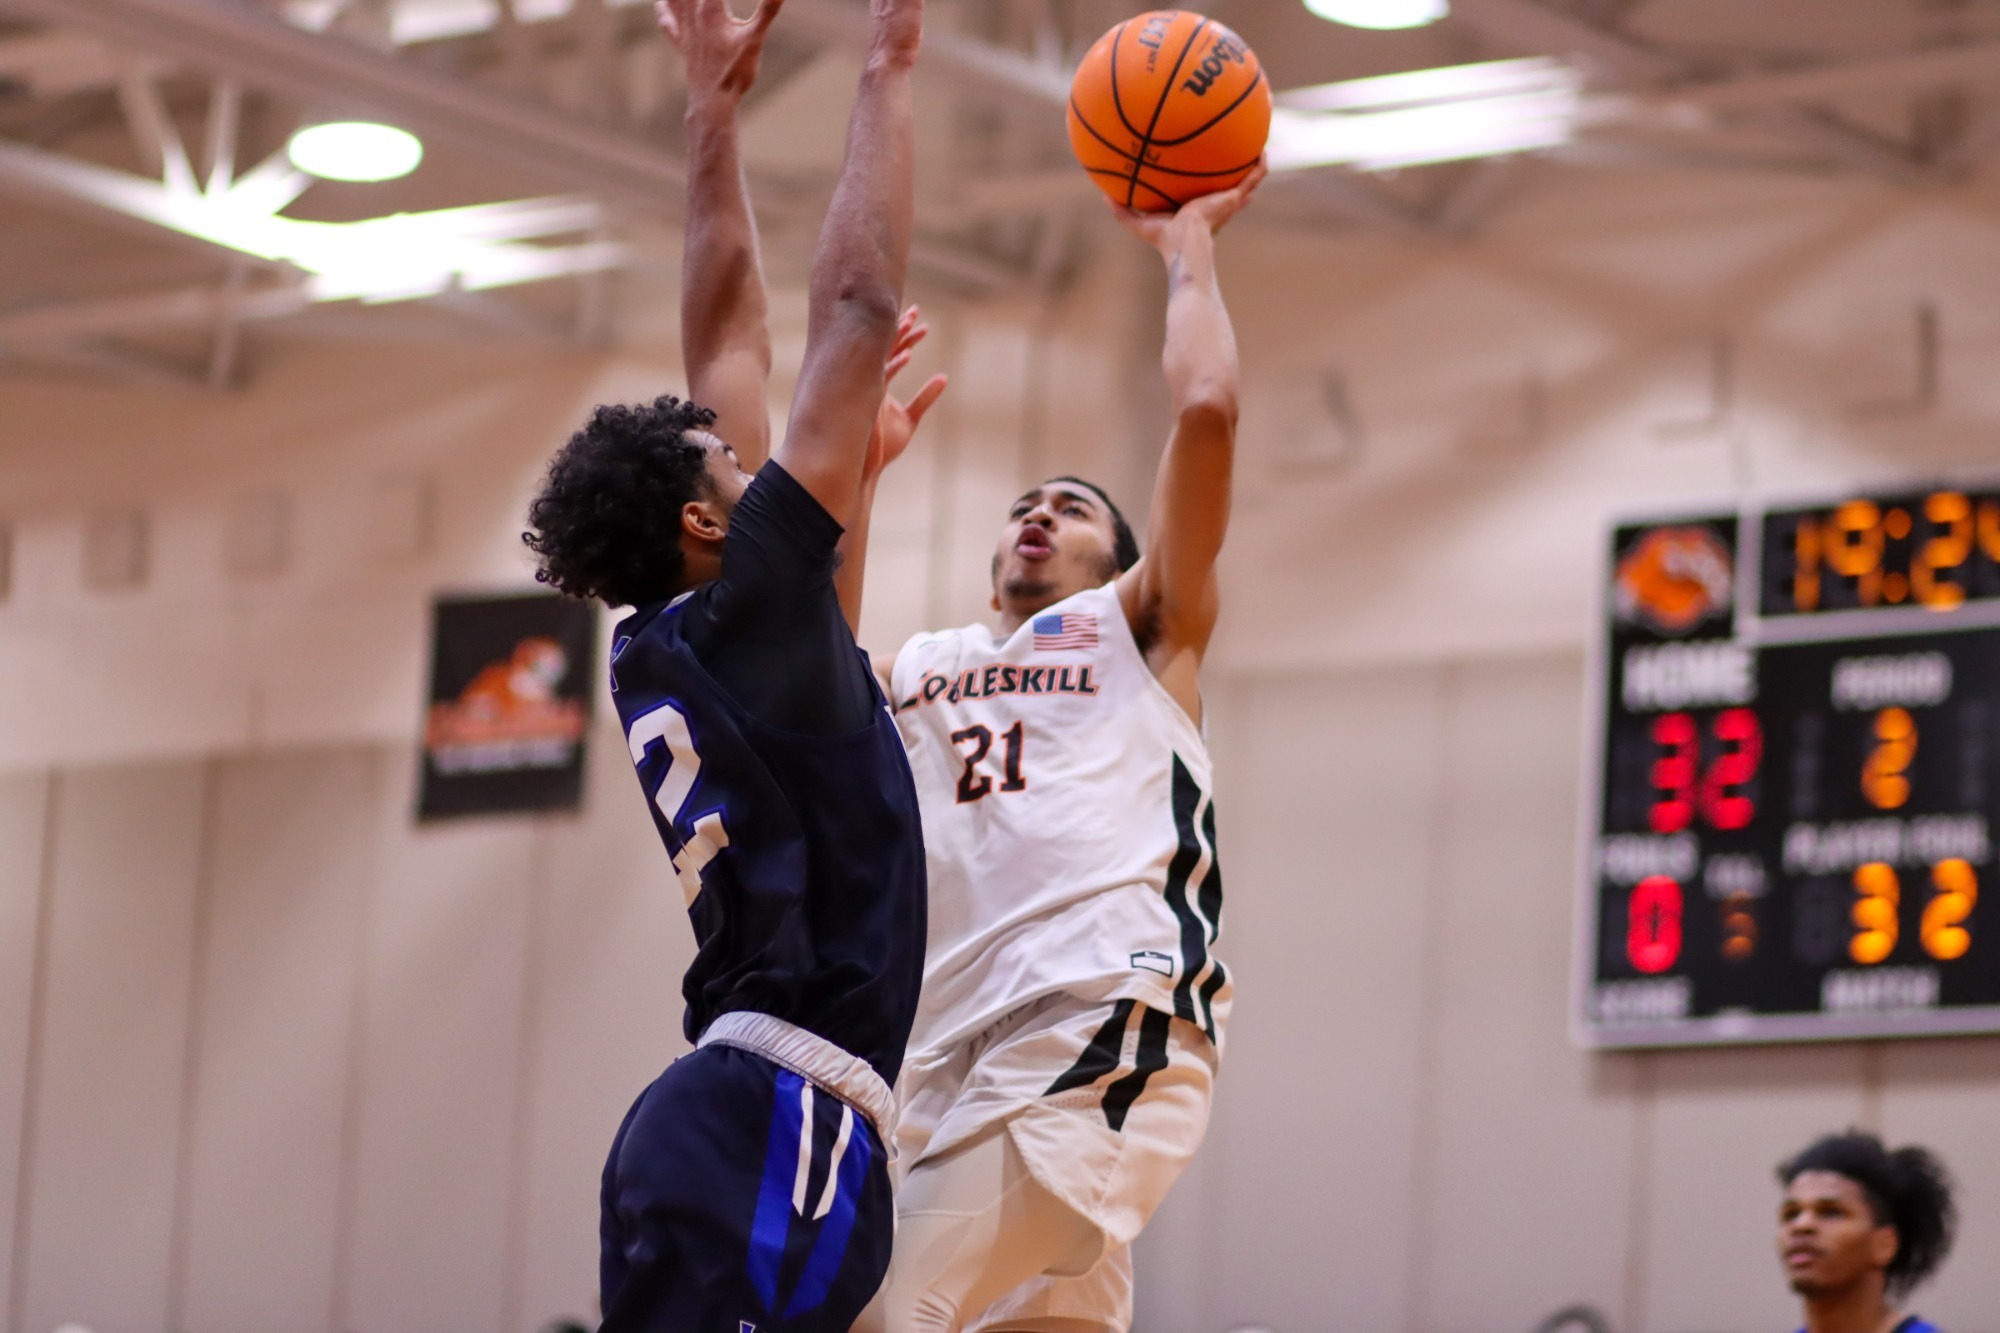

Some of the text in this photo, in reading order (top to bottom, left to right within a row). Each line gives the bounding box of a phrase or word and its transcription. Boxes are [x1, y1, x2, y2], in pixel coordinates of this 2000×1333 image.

[951, 720, 1026, 804] 21
[1647, 707, 1763, 833] 32
[1861, 707, 1918, 810] 2
[1626, 875, 1684, 974] 0
